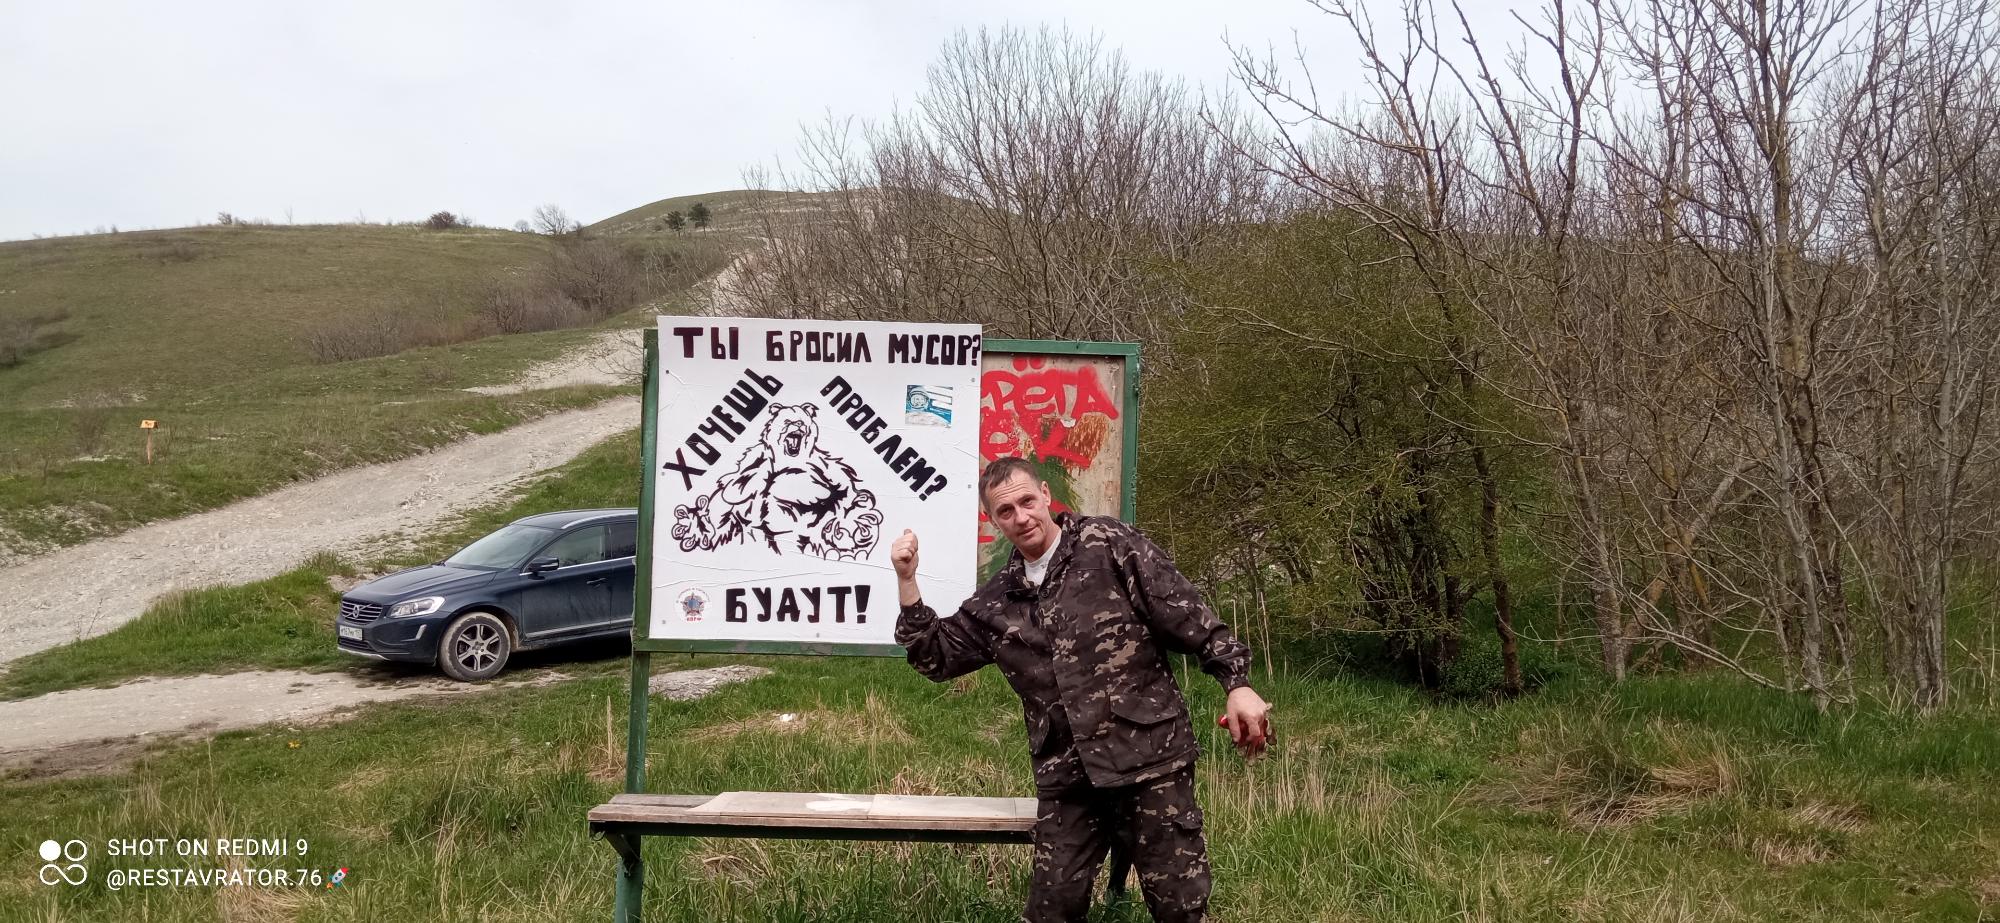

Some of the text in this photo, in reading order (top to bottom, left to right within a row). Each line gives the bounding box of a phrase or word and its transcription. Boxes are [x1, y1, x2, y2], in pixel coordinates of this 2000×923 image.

[673, 326, 982, 367] ТЫ БРОСИЛ МУСОР?
[662, 368, 784, 492] ХОЧЕШЬ
[819, 375, 948, 501] ПРОБЛЕМ?
